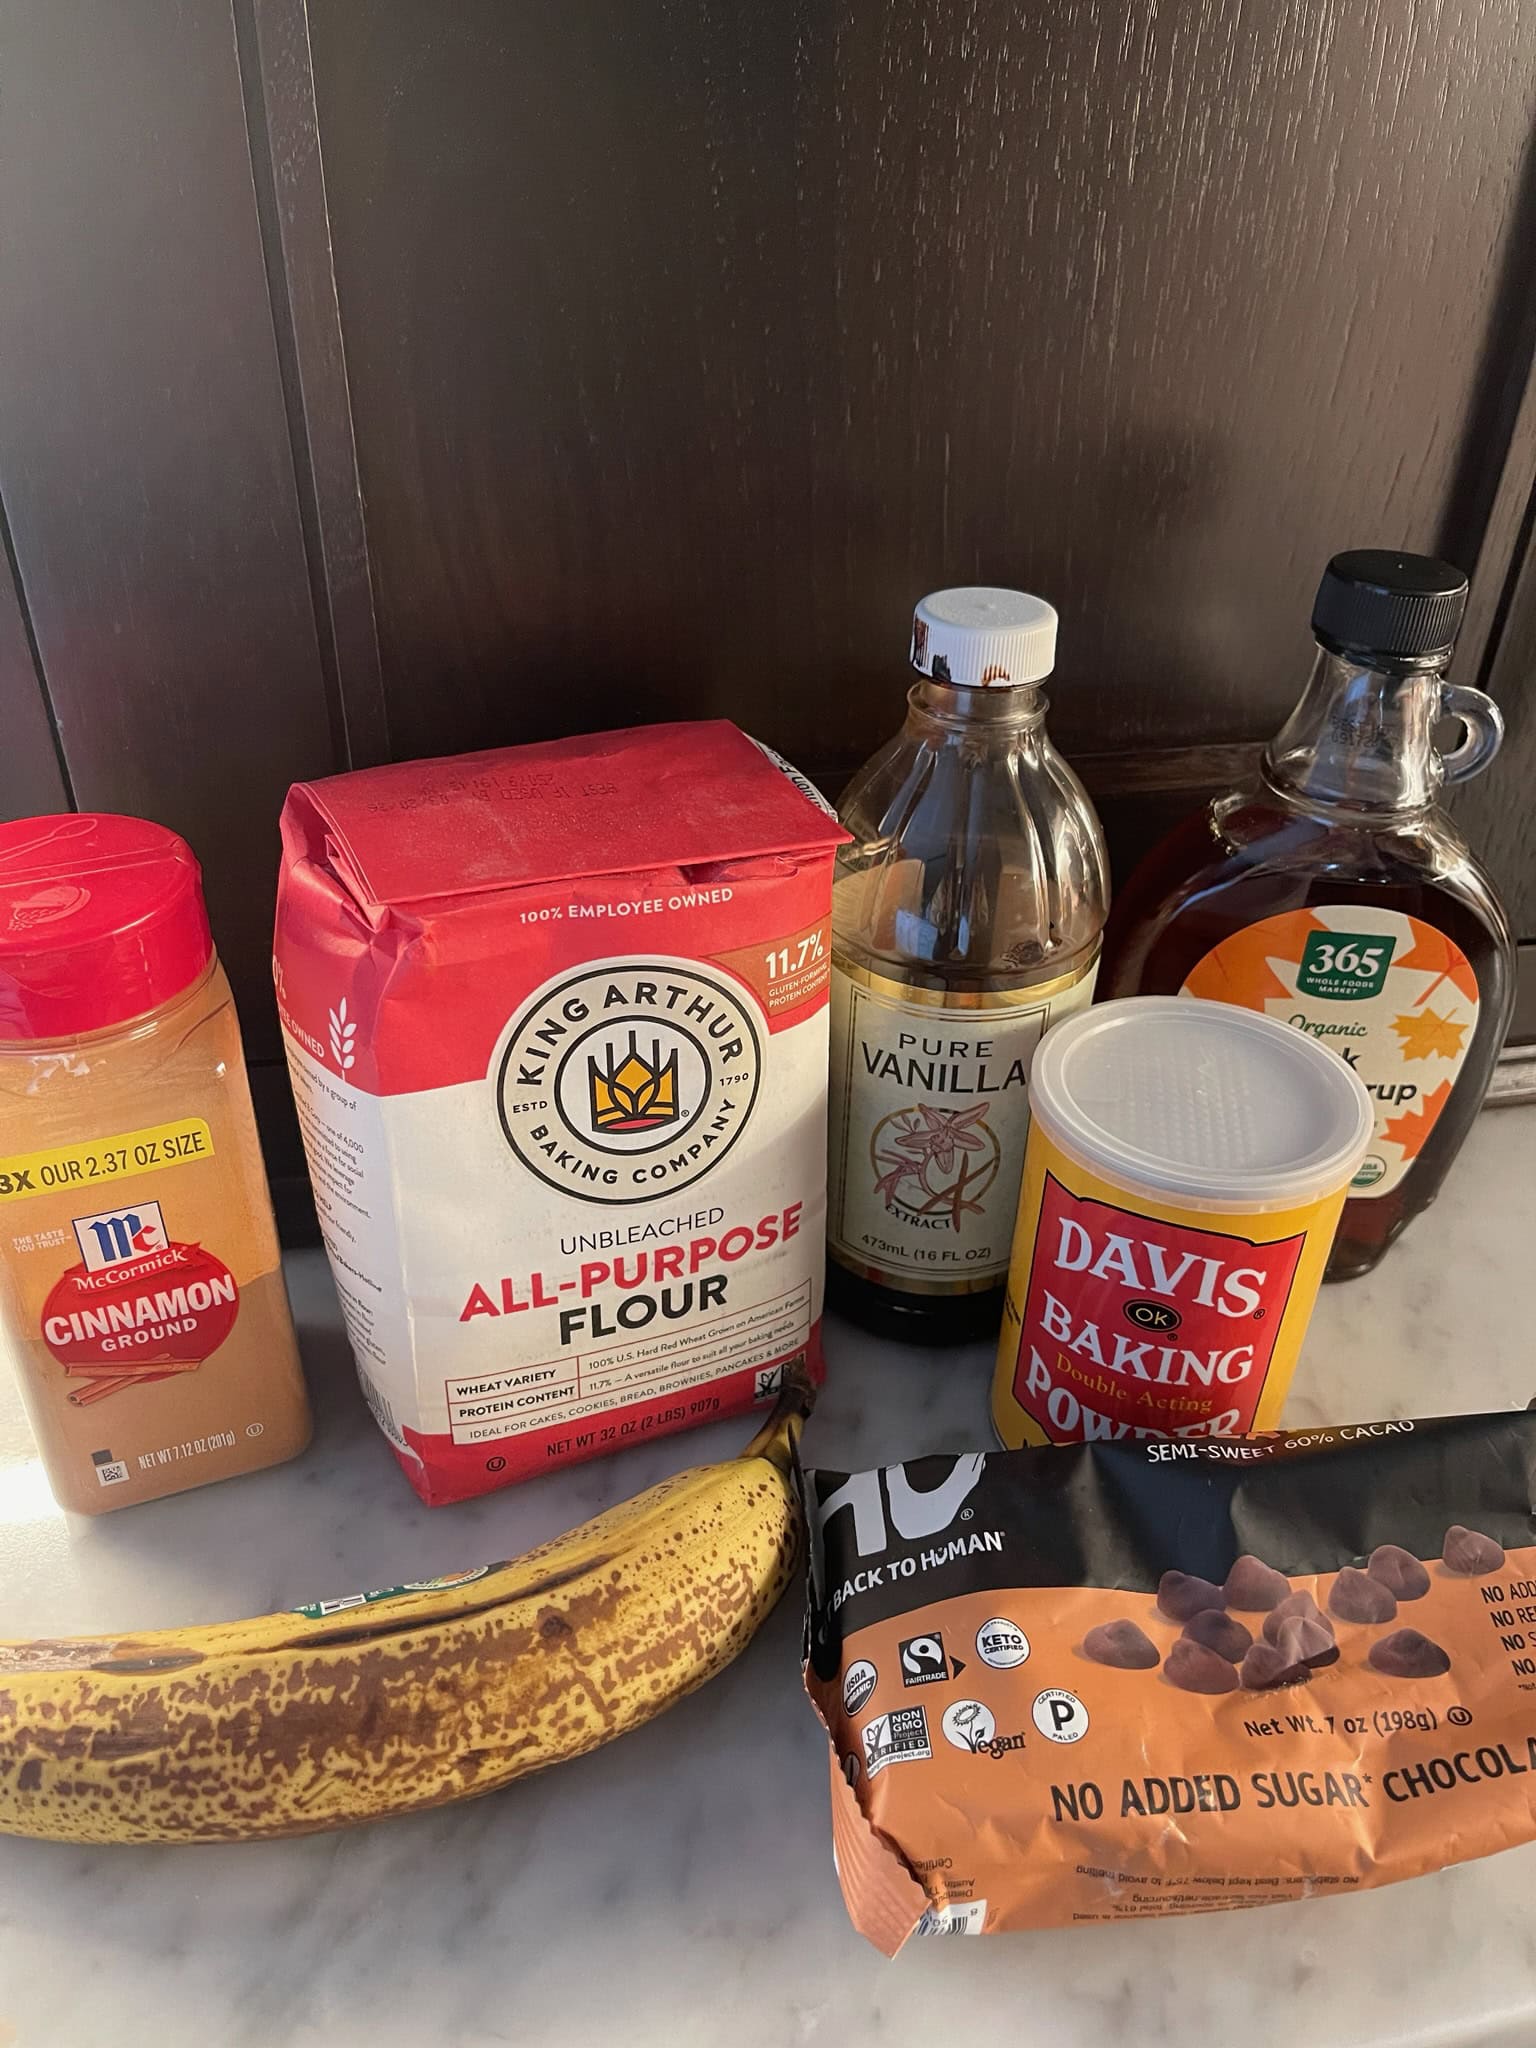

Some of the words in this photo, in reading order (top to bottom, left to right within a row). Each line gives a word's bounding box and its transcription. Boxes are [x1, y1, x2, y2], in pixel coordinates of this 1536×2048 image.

[520, 907, 563, 924] 100%
[568, 898, 663, 918] EMPLOYEE
[668, 888, 733, 910] OWNED
[765, 929, 823, 978] 11.7%
[1309, 942, 1385, 977] 365
[1306, 977, 1339, 986] WHOLE
[1342, 979, 1374, 988] FOODS
[1319, 985, 1358, 995] MARKET
[769, 988, 802, 1007] PROTEIN
[516, 997, 590, 1086] KING
[604, 981, 744, 1064] ARTHUR
[1288, 1014, 1368, 1039] Organic
[899, 1033, 994, 1058] PURE
[719, 1072, 750, 1087] 1790
[861, 1041, 1027, 1094] VANILLA
[512, 1100, 549, 1114] ESTD
[530, 1124, 618, 1184] BAKING
[632, 1098, 736, 1184] COMPANY
[40, 1160, 84, 1186] OUR
[85, 1149, 127, 1177] 2.37
[134, 1143, 160, 1166] OZ
[162, 1131, 206, 1159] SIZE
[885, 1203, 951, 1230] EXTRACT
[13, 1236, 33, 1245] THE
[35, 1229, 65, 1241] TASTE
[560, 1207, 725, 1255] UNBLEACHED
[14, 1243, 36, 1254] YOU
[861, 1234, 909, 1257] 473mL
[914, 1248, 937, 1261] (16
[942, 1251, 961, 1261] FL
[965, 1247, 991, 1260] OZ)
[72, 1249, 188, 1291] McCormick
[459, 1201, 804, 1323] ALL-PURPOSE
[1054, 1217, 1267, 1318] DAVIS
[44, 1274, 236, 1345] CINNAMON
[559, 1274, 729, 1345] FLOUR
[1135, 1307, 1169, 1327] OK
[101, 1318, 197, 1352] GROUND
[589, 1356, 615, 1370] 100%
[616, 1352, 635, 1363] U.S.
[636, 1346, 659, 1359] Hard
[660, 1340, 678, 1353] Red
[680, 1333, 706, 1348] Wheat
[708, 1325, 735, 1338] Grown
[736, 1321, 747, 1329] on
[747, 1306, 784, 1325] American
[1040, 1289, 1254, 1387] BAKING
[589, 1378, 612, 1392] 11.7%
[625, 1373, 633, 1382] A
[633, 1363, 669, 1380] versatile
[670, 1357, 690, 1369] flour
[691, 1354, 701, 1364] to
[702, 1349, 717, 1361] suit
[718, 1344, 728, 1356] all
[729, 1339, 747, 1354] your
[748, 1329, 774, 1346] baking
[773, 1320, 795, 1335] needs
[456, 1381, 502, 1396] WHEAT
[504, 1369, 557, 1388] VARIETY
[470, 1426, 501, 1439] IDEAL
[504, 1421, 527, 1433] FOR
[529, 1411, 566, 1426] CAKES,
[568, 1398, 618, 1416] COOKIES,
[620, 1387, 657, 1403] BREAD,
[659, 1371, 713, 1393] BROWNIES,
[715, 1352, 765, 1375] PANCAKES
[774, 1338, 800, 1354] MORE
[1056, 1351, 1127, 1399] Double
[1136, 1393, 1213, 1413] Acting
[459, 1399, 515, 1418] PROTEIN
[517, 1386, 575, 1407] CONTENT
[547, 1439, 573, 1457] NET
[576, 1432, 597, 1448] WT
[600, 1427, 616, 1441] 32
[620, 1420, 638, 1435] OZ
[640, 1415, 654, 1430] (2
[657, 1405, 687, 1424] LBS)
[1147, 1444, 1276, 1463] SEMI-SWEET
[1284, 1433, 1334, 1449] 60%
[1340, 1421, 1415, 1440] CACAO
[138, 1453, 157, 1470] NET
[157, 1448, 172, 1465] WT
[172, 1442, 193, 1460] 7.12
[194, 1439, 207, 1454] OZ
[833, 1567, 884, 1612] BACK
[887, 1558, 916, 1580] TO
[1481, 1586, 1505, 1604] NO
[1490, 1610, 1515, 1628] NO
[982, 1634, 1022, 1648] KETO
[984, 1645, 1024, 1654] CERTIFIED
[1500, 1634, 1525, 1651] NO
[905, 1671, 947, 1685] FAIRTRADE
[1511, 1658, 1536, 1676] NO
[847, 1669, 866, 1693] USDA
[1038, 1691, 1076, 1704] CERTIFIED
[892, 1709, 920, 1723] NON
[893, 1719, 923, 1732] GMO
[1049, 1700, 1075, 1731] P
[1244, 1718, 1284, 1737] Net
[1286, 1715, 1323, 1733] Wt.
[1344, 1717, 1368, 1733] oz
[1373, 1708, 1438, 1737] (198g)
[893, 1728, 924, 1739] Project
[956, 1732, 1025, 1759] Vegan
[1052, 1732, 1079, 1740] PALEO
[868, 1739, 926, 1765] VERIFIED
[1051, 1782, 1103, 1822] NO
[1121, 1774, 1241, 1817] ADDED
[1118, 1873, 1148, 1884] avoid
